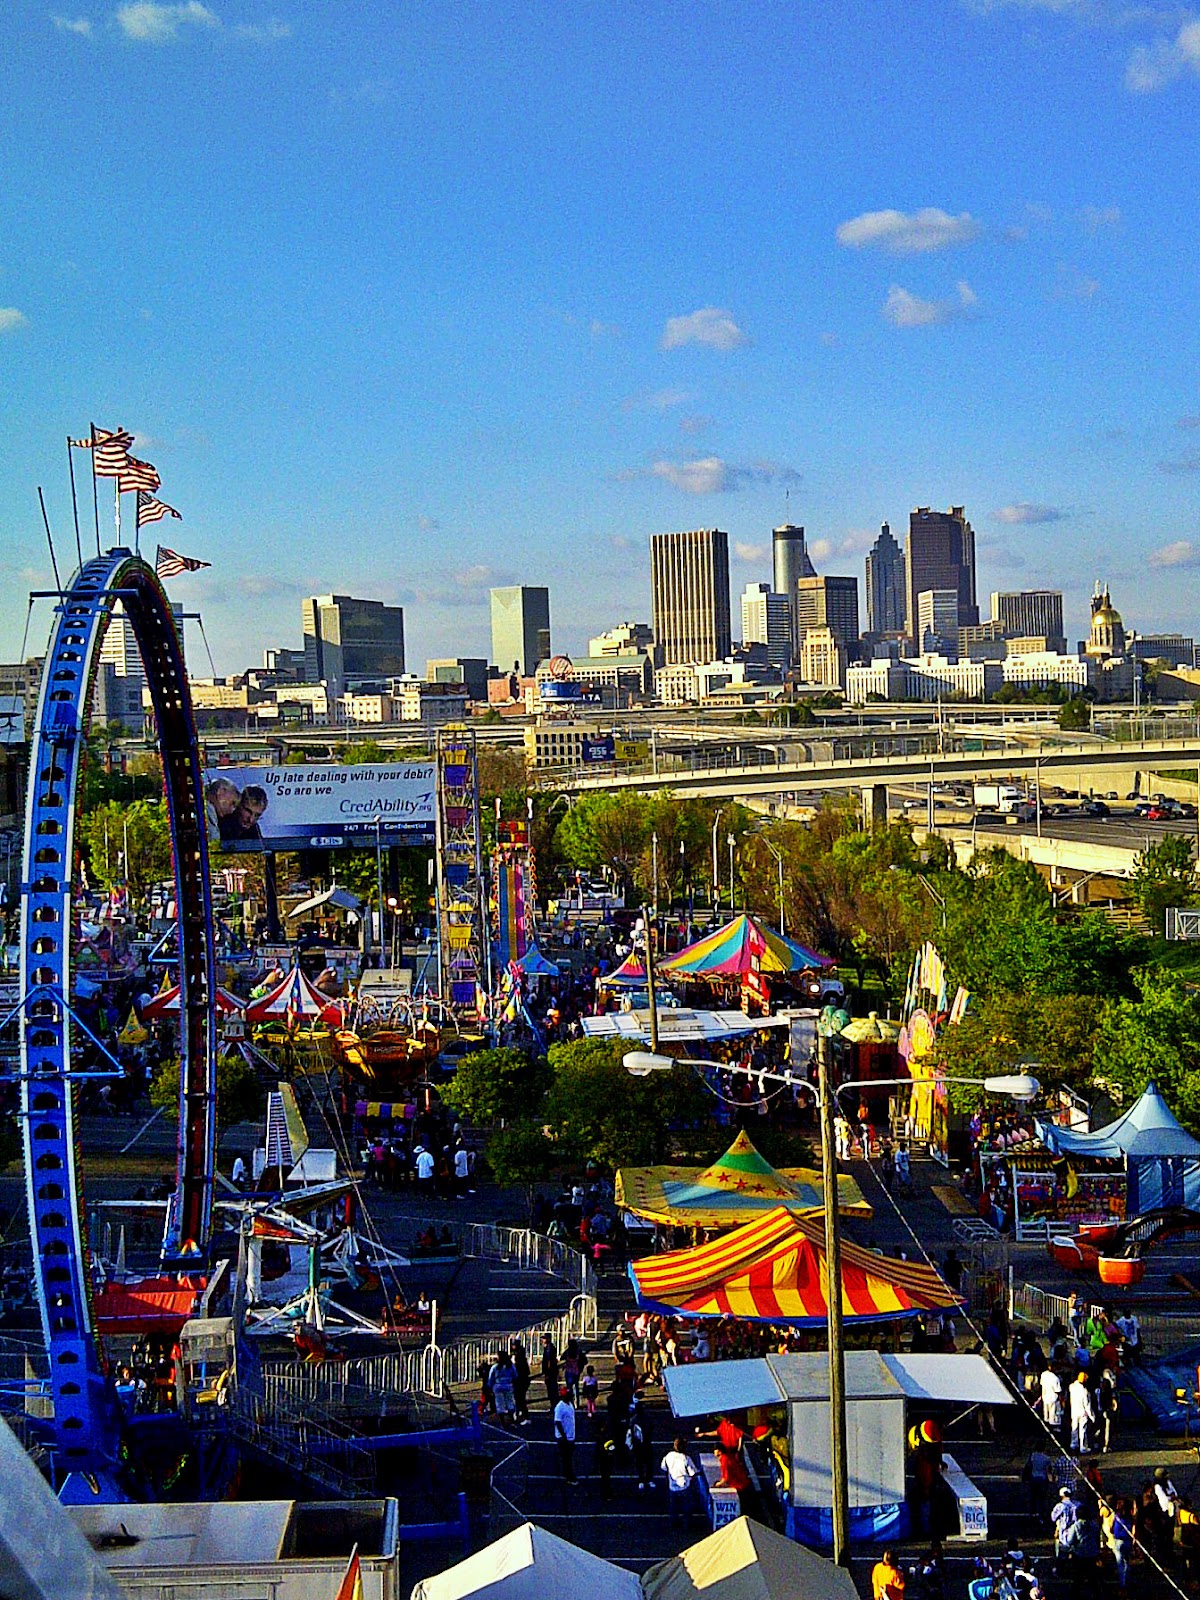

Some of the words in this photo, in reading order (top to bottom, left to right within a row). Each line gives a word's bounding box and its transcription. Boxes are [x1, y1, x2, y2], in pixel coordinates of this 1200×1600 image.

[265, 772, 280, 785] Up
[283, 772, 304, 782] late
[306, 770, 347, 784] dealing
[350, 769, 375, 781] with
[377, 770, 401, 783] your
[403, 767, 434, 780] debt?
[276, 785, 291, 796] So
[294, 787, 312, 795] are
[344, 824, 359, 832] 24/7
[384, 822, 427, 830] Confidential
[715, 1502, 737, 1512] WIN
[965, 1512, 985, 1523] BIG
